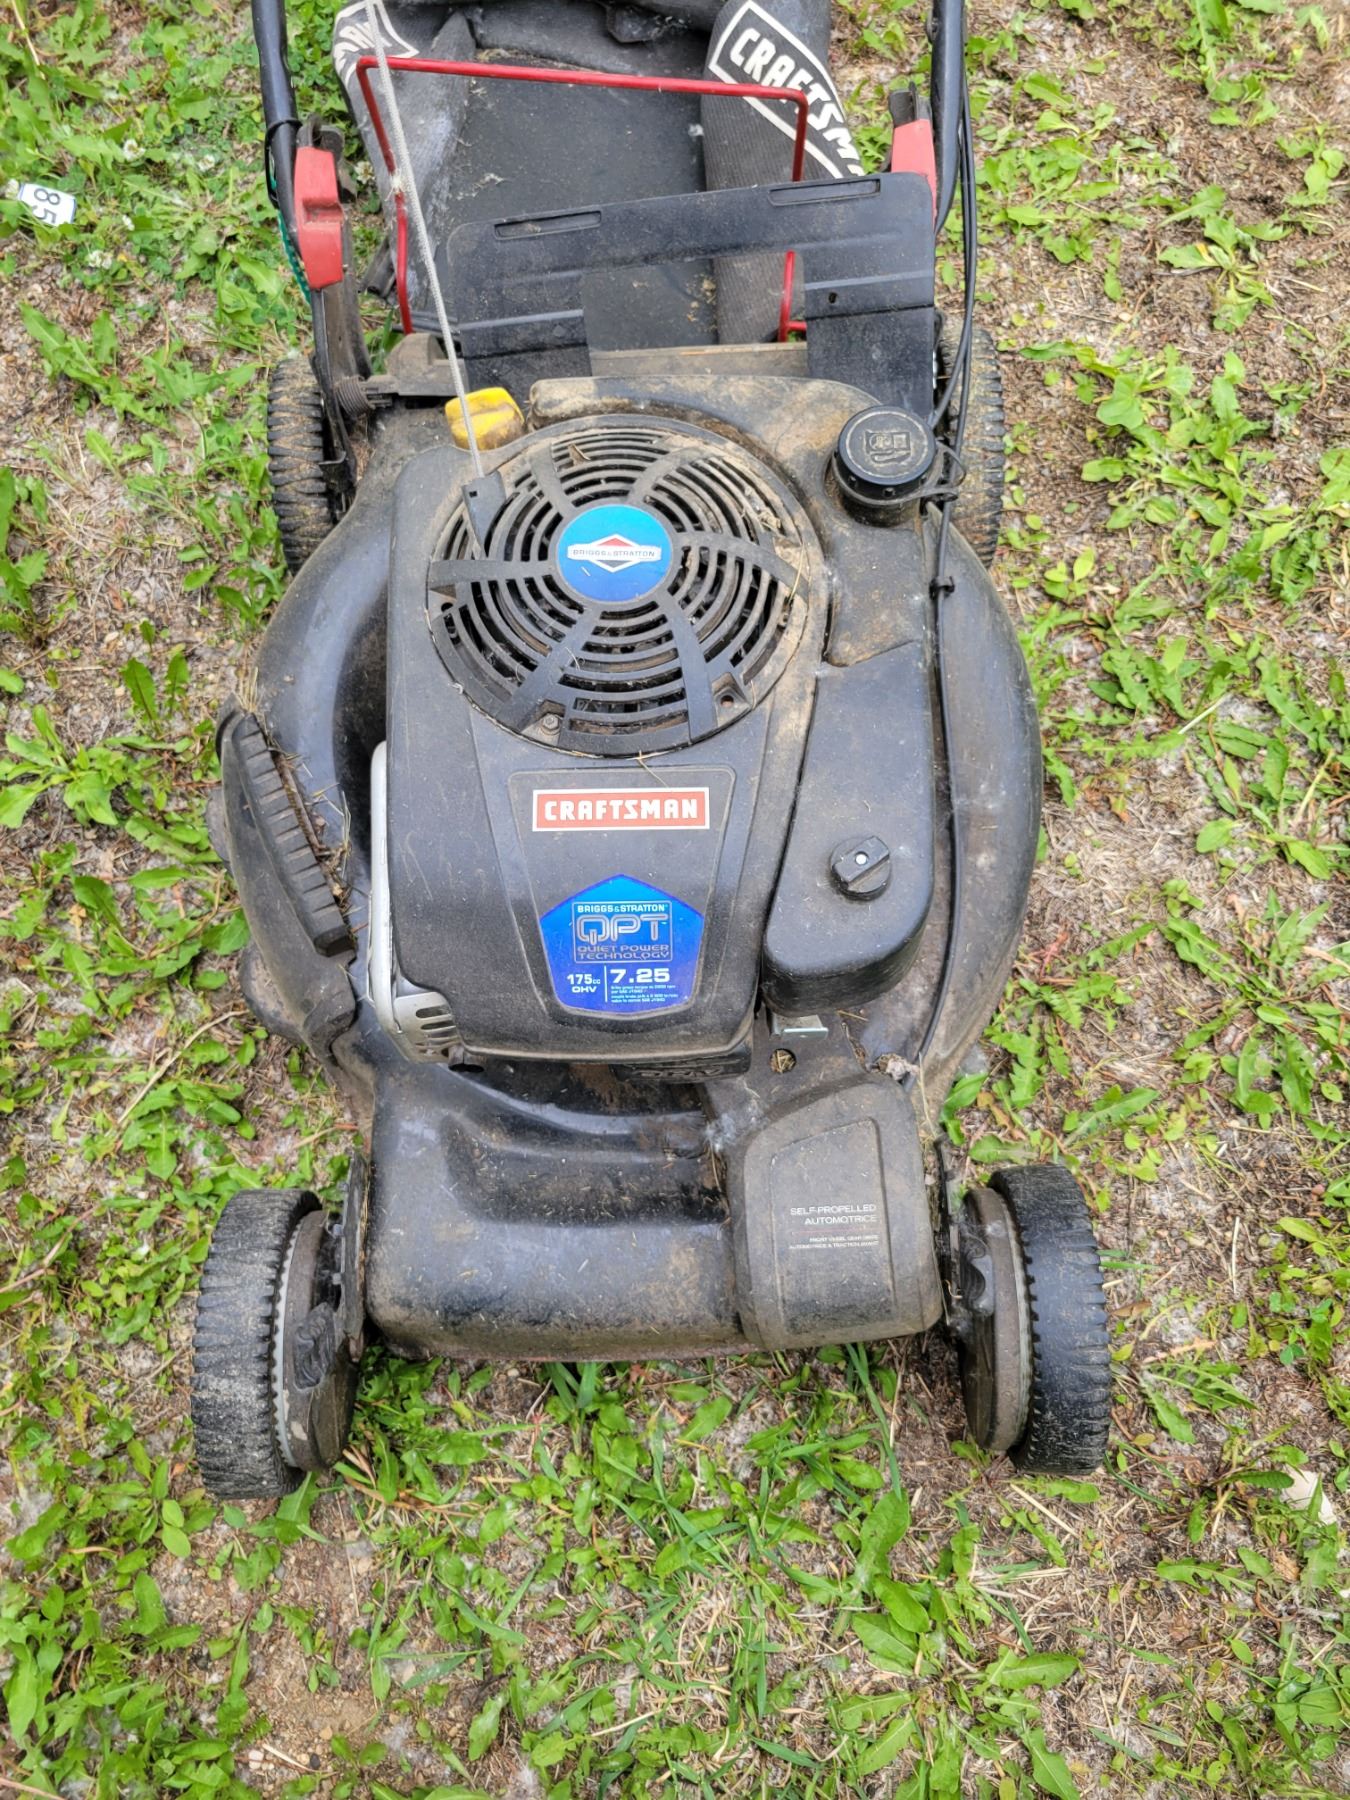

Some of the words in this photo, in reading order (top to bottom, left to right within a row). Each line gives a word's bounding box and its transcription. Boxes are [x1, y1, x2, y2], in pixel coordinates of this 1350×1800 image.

[730, 28, 866, 176] CRAFTSM
[544, 798, 698, 821] CRAFTSMAN
[576, 913, 669, 945] QPT
[577, 945, 617, 953] QUIET
[620, 944, 669, 952] POWER
[577, 951, 670, 960] TECHNOLOGY
[610, 968, 671, 983] 7.25
[790, 1204, 877, 1216] SELF-PROPELLED
[804, 1214, 878, 1225] AUTOMOTRICE
